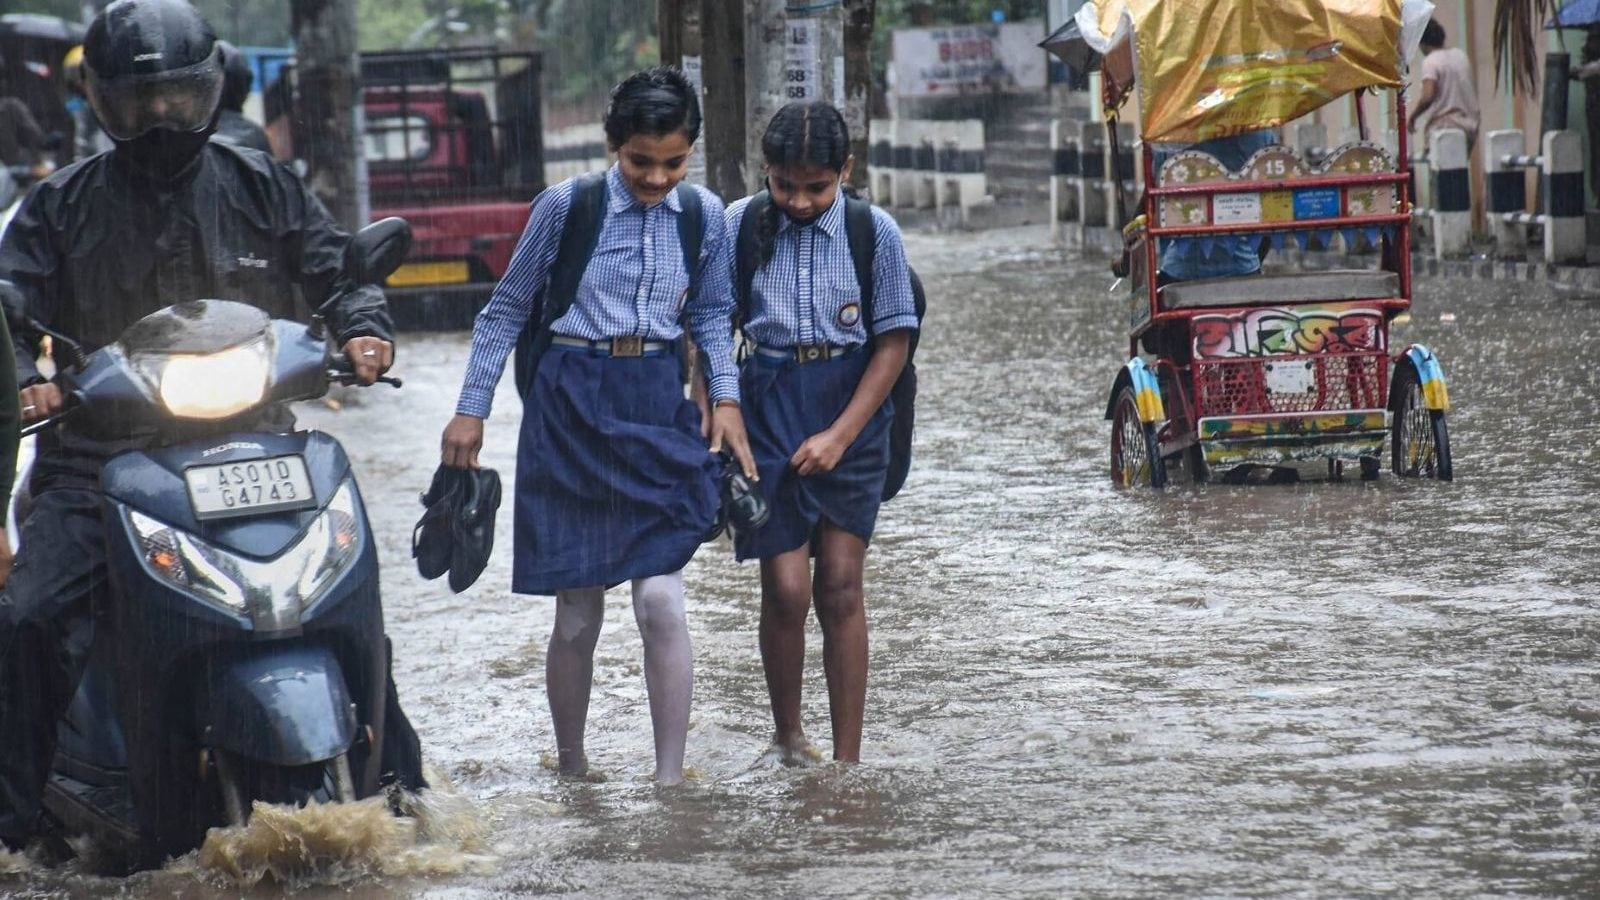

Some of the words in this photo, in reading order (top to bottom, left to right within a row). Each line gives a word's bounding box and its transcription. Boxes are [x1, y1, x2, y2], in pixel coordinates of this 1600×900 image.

[1265, 159, 1285, 175] 15
[202, 441, 264, 457] HONDA
[219, 460, 289, 486] AS01D
[222, 482, 296, 507] G4743
